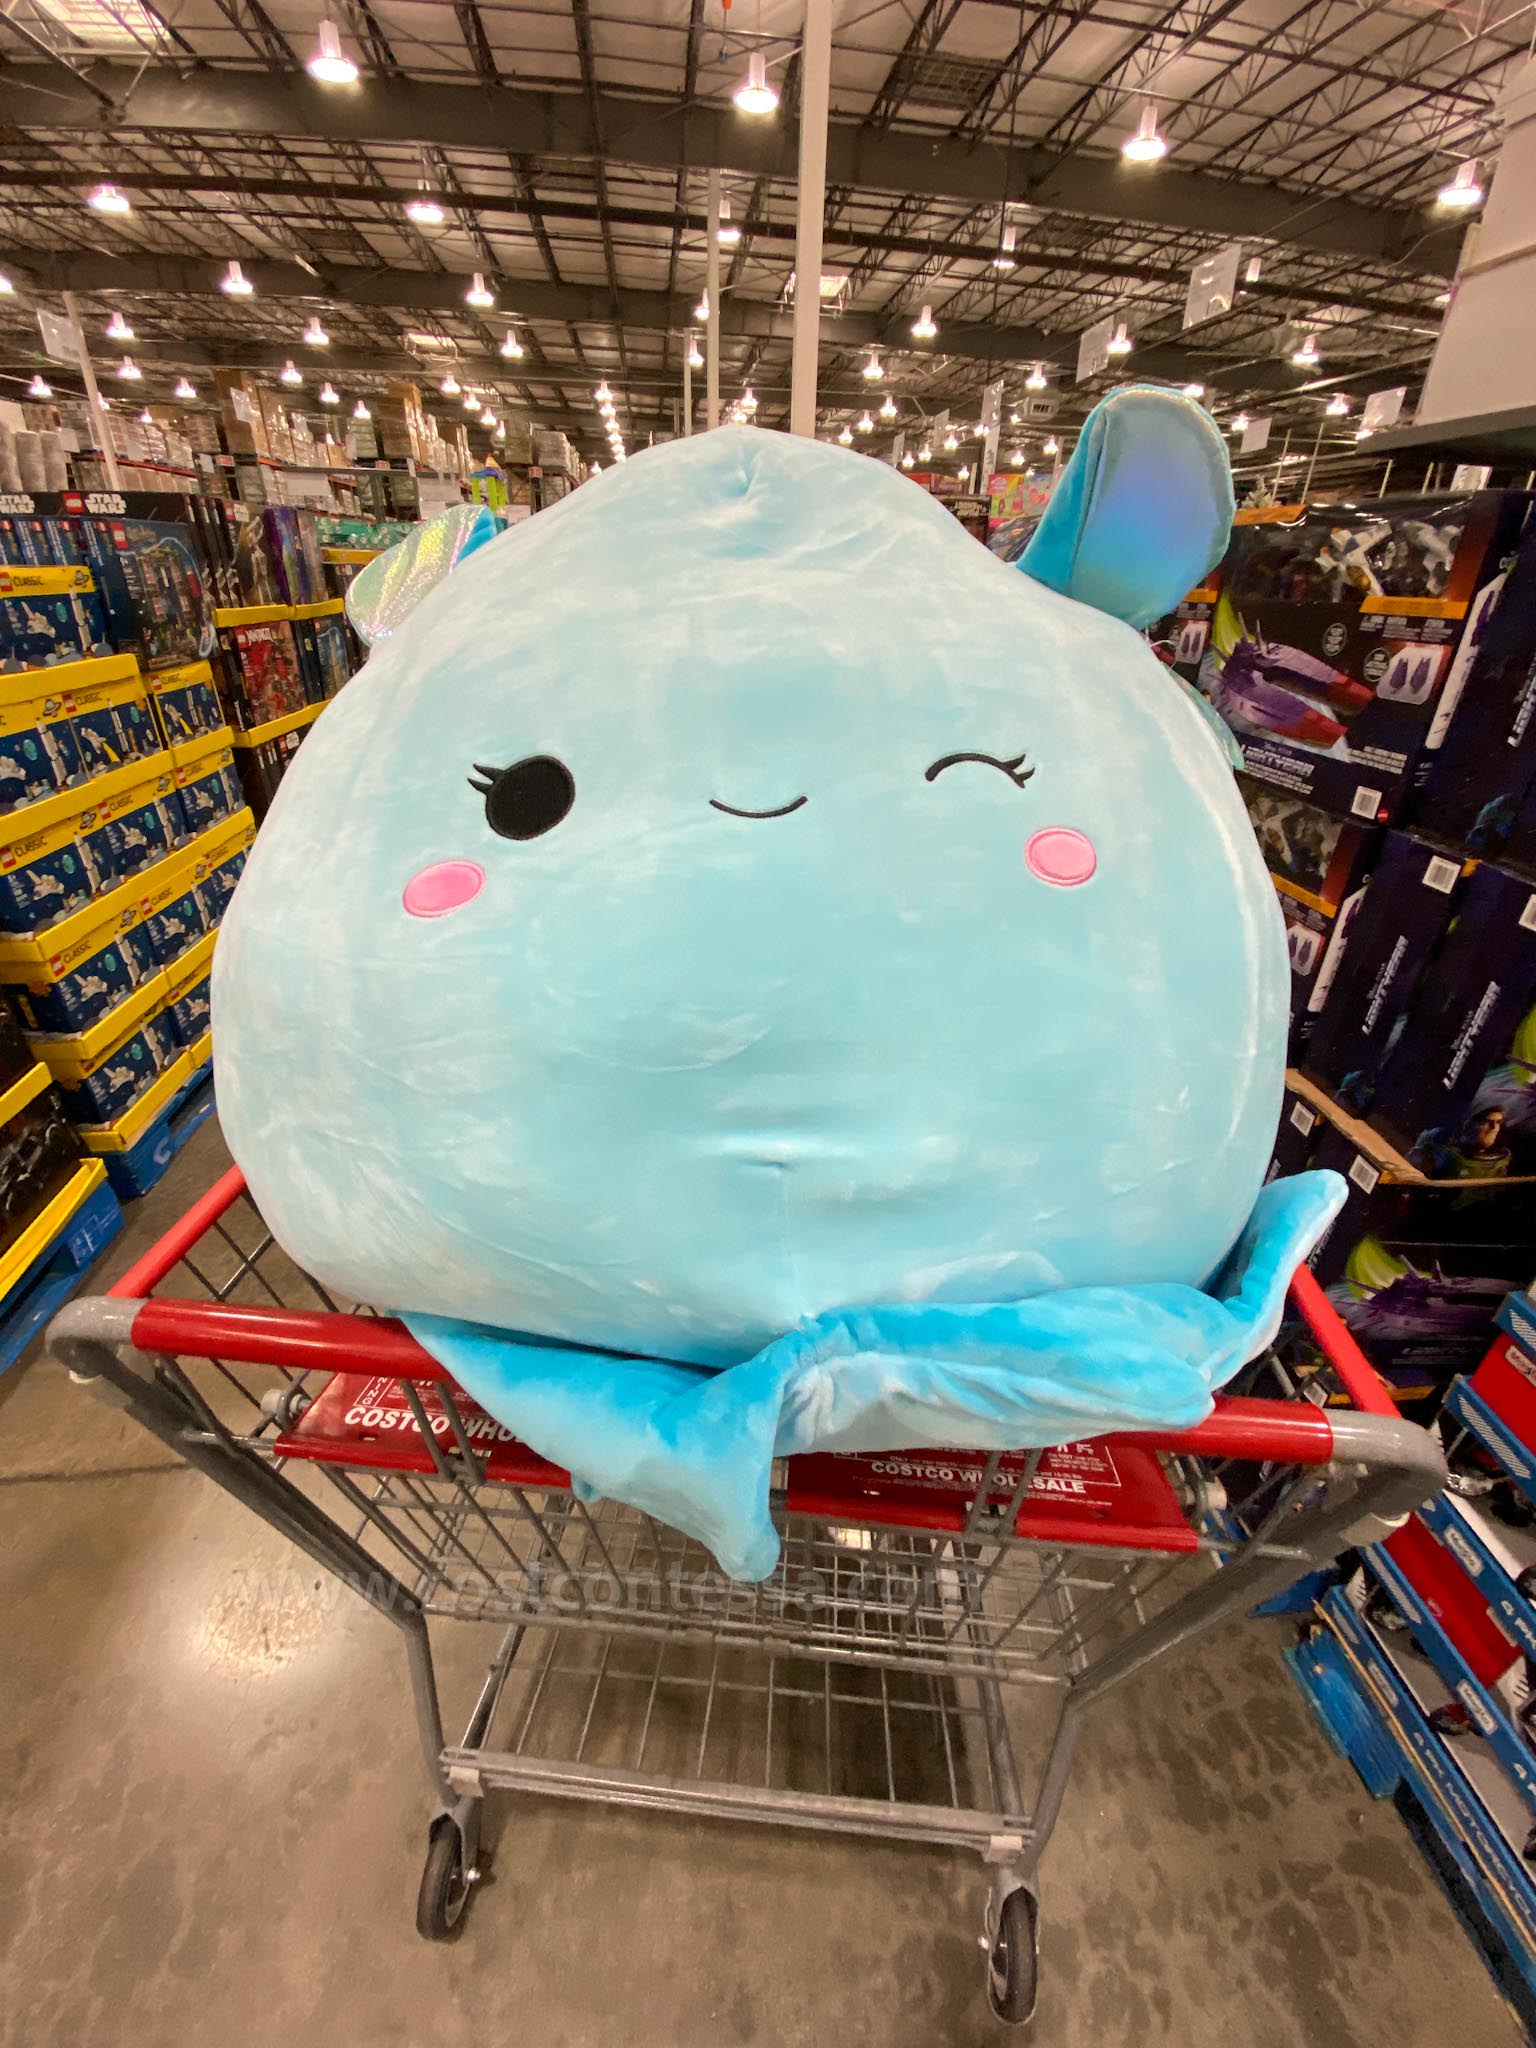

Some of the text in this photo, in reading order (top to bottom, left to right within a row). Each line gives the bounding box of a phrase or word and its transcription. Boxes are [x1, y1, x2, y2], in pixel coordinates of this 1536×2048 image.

[13, 575, 44, 587] CLASSIC
[75, 692, 103, 706] CLASSIC
[108, 794, 134, 812] CLASSIC
[14, 836, 48, 858] CLASSIC
[63, 940, 93, 964] CLASSIC
[344, 1406, 450, 1434] COSTCO
[871, 1461, 954, 1481] COSTCO
[958, 1470, 1086, 1494] WOLSALE
